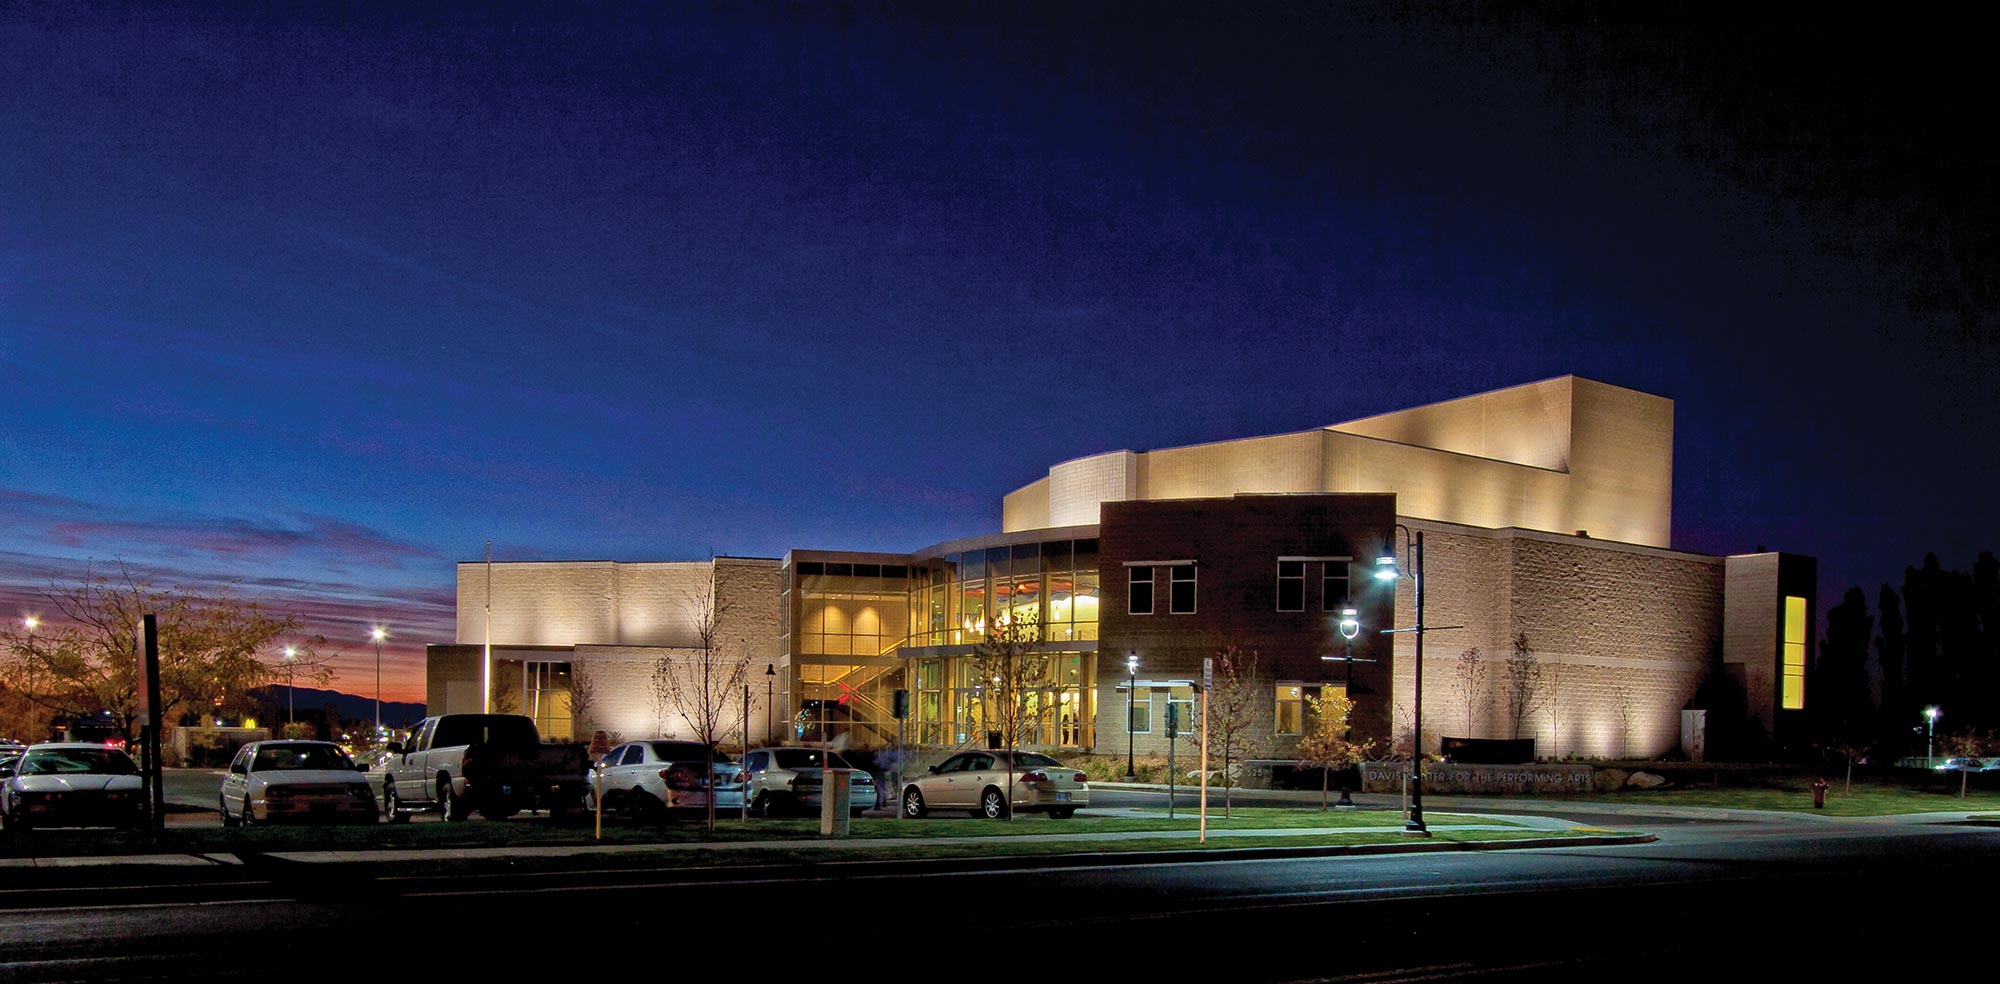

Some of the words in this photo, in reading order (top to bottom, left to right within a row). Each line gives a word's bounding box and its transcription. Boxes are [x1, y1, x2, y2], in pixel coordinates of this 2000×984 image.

[1369, 771, 1400, 781] DAVIS
[1405, 771, 1444, 782] CNTER
[1450, 772, 1472, 782] FOR
[1475, 773, 1492, 782] THE
[1497, 773, 1562, 783] PERFORMING
[1568, 773, 1591, 783] ARTS
